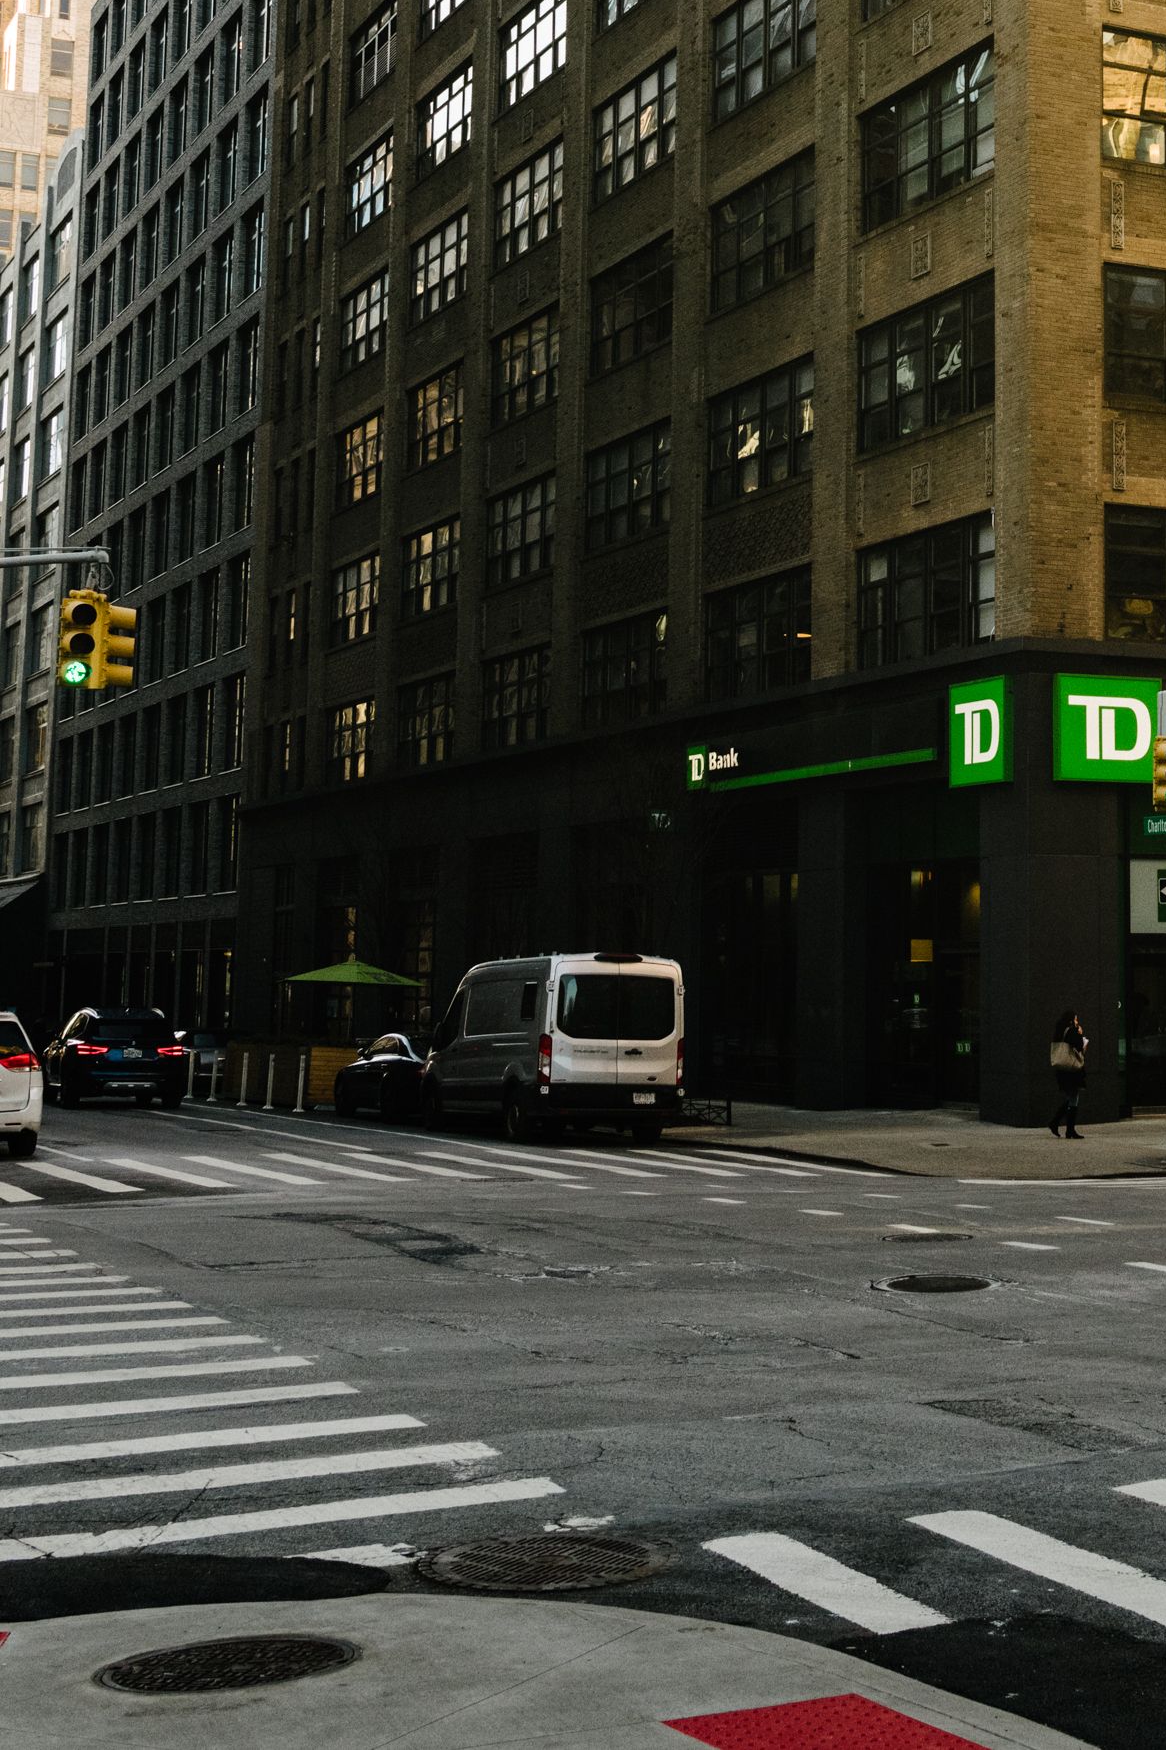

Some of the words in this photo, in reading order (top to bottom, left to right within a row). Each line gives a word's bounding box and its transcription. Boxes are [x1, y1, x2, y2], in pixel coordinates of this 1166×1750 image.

[954, 699, 1000, 765] TD
[1067, 694, 1152, 761] TD
[688, 753, 705, 782] TD
[708, 747, 739, 771] Bank
